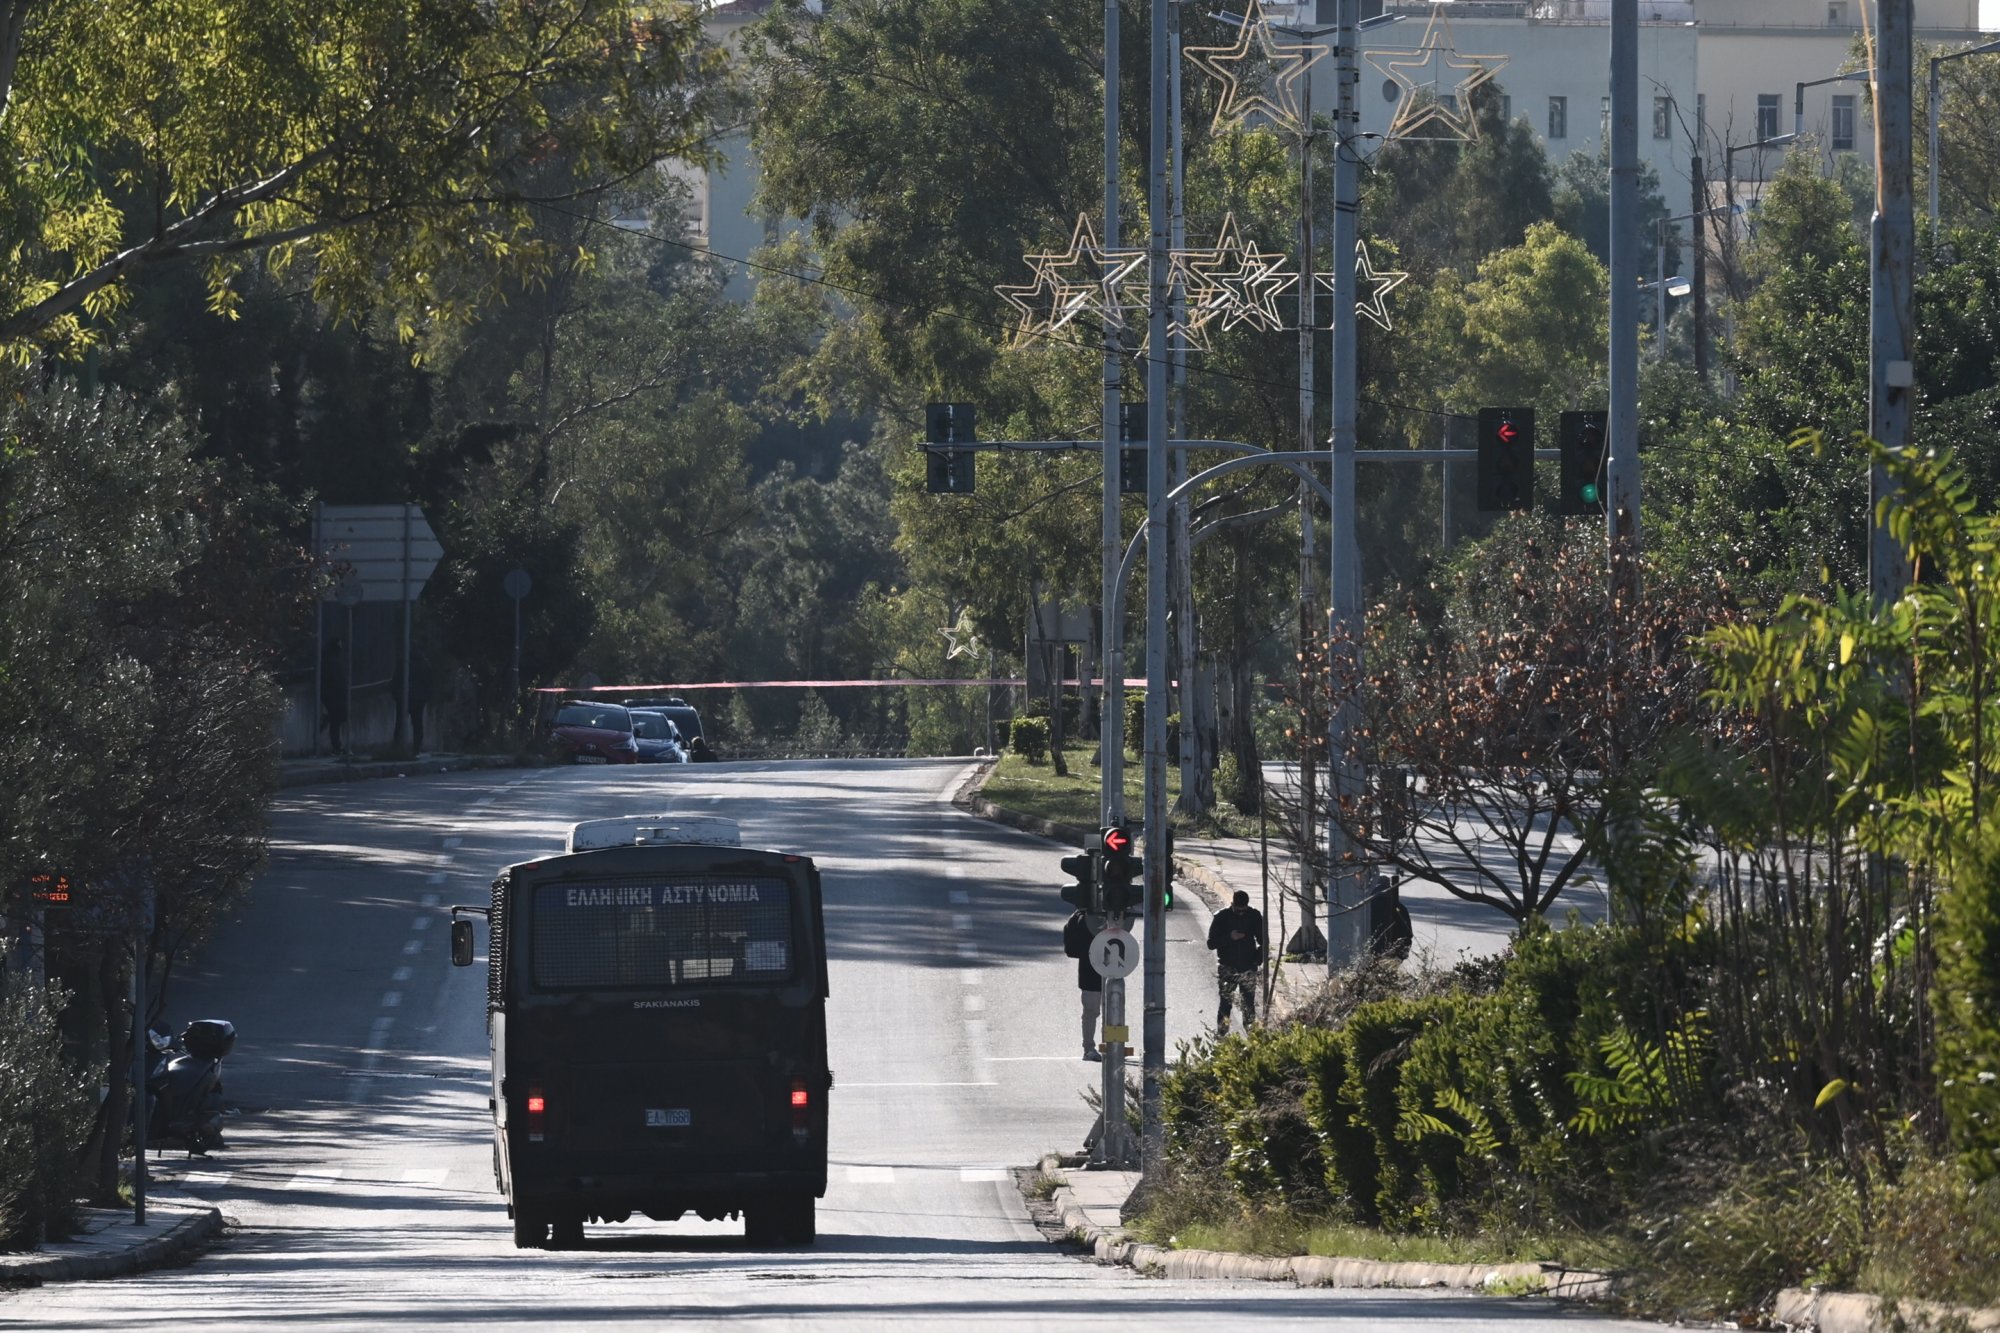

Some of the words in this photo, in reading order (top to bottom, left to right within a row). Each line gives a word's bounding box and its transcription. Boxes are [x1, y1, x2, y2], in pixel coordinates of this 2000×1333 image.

[567, 888, 652, 906] ΕΛΛΗΝΙΚΗ
[662, 885, 760, 903] ΑΣΤΥΝΟΜΙΑ
[633, 999, 701, 1009] SFAKIANAKIS
